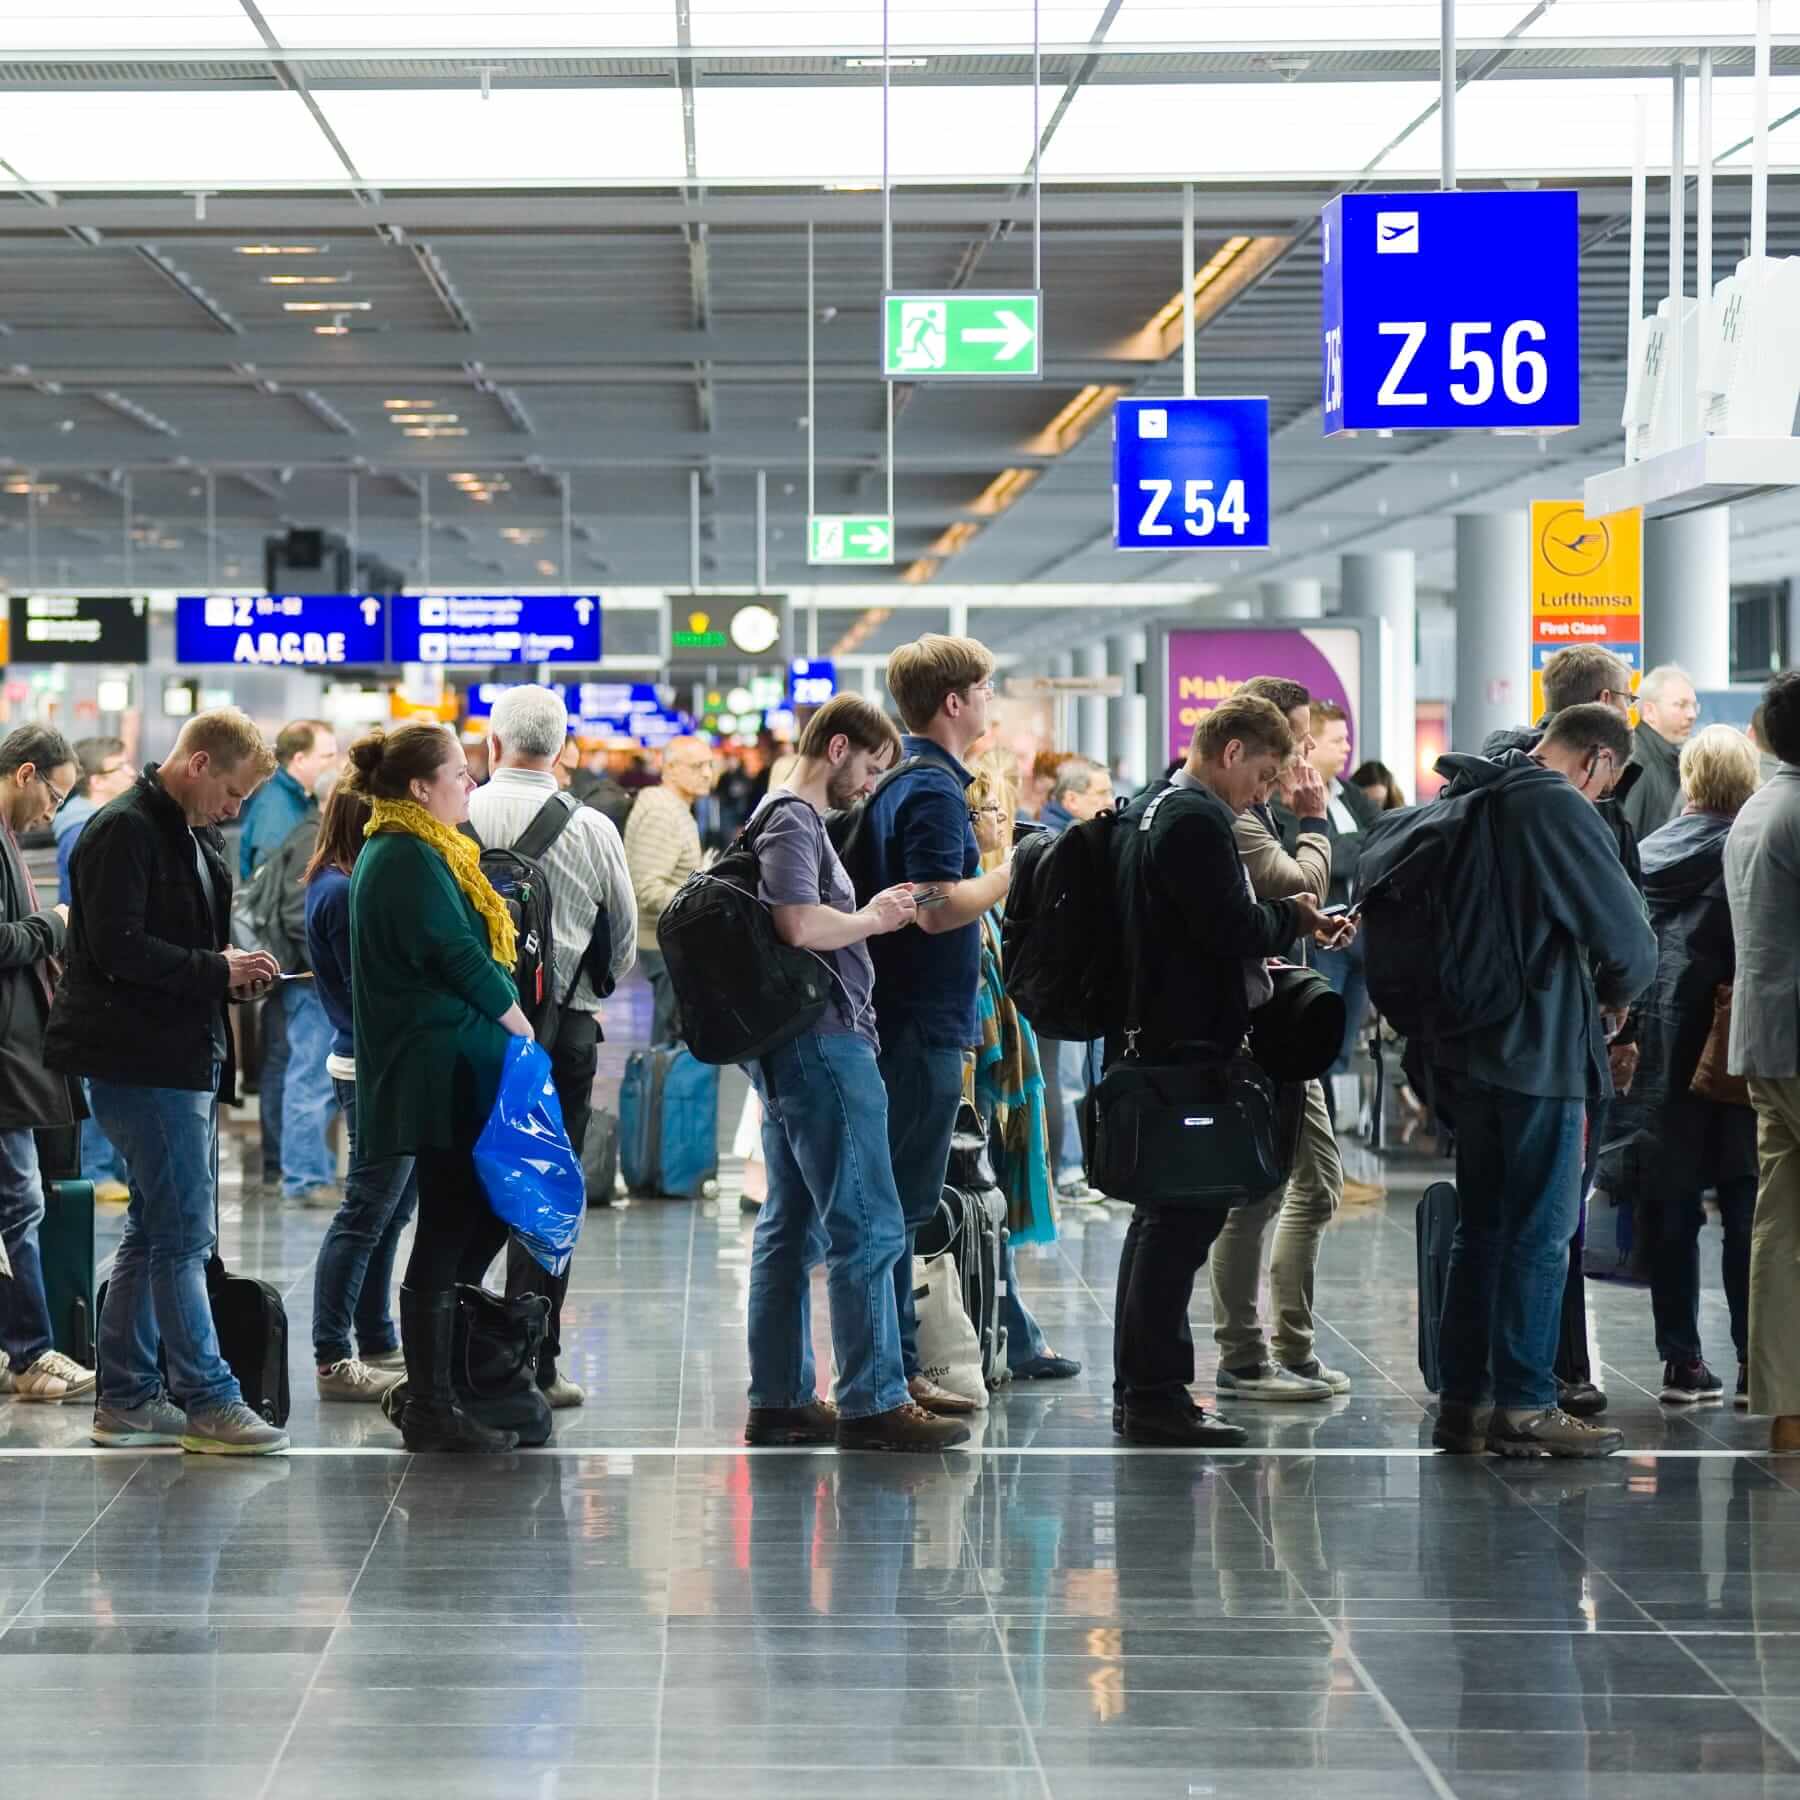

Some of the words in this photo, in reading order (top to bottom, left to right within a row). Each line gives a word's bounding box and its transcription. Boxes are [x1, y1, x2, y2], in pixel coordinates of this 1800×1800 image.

[1377, 321, 1428, 406] Z
[1449, 319, 1548, 406] 56
[1138, 479, 1173, 536] Z
[1184, 479, 1250, 537] 54
[1541, 592, 1632, 607] Lufthansa
